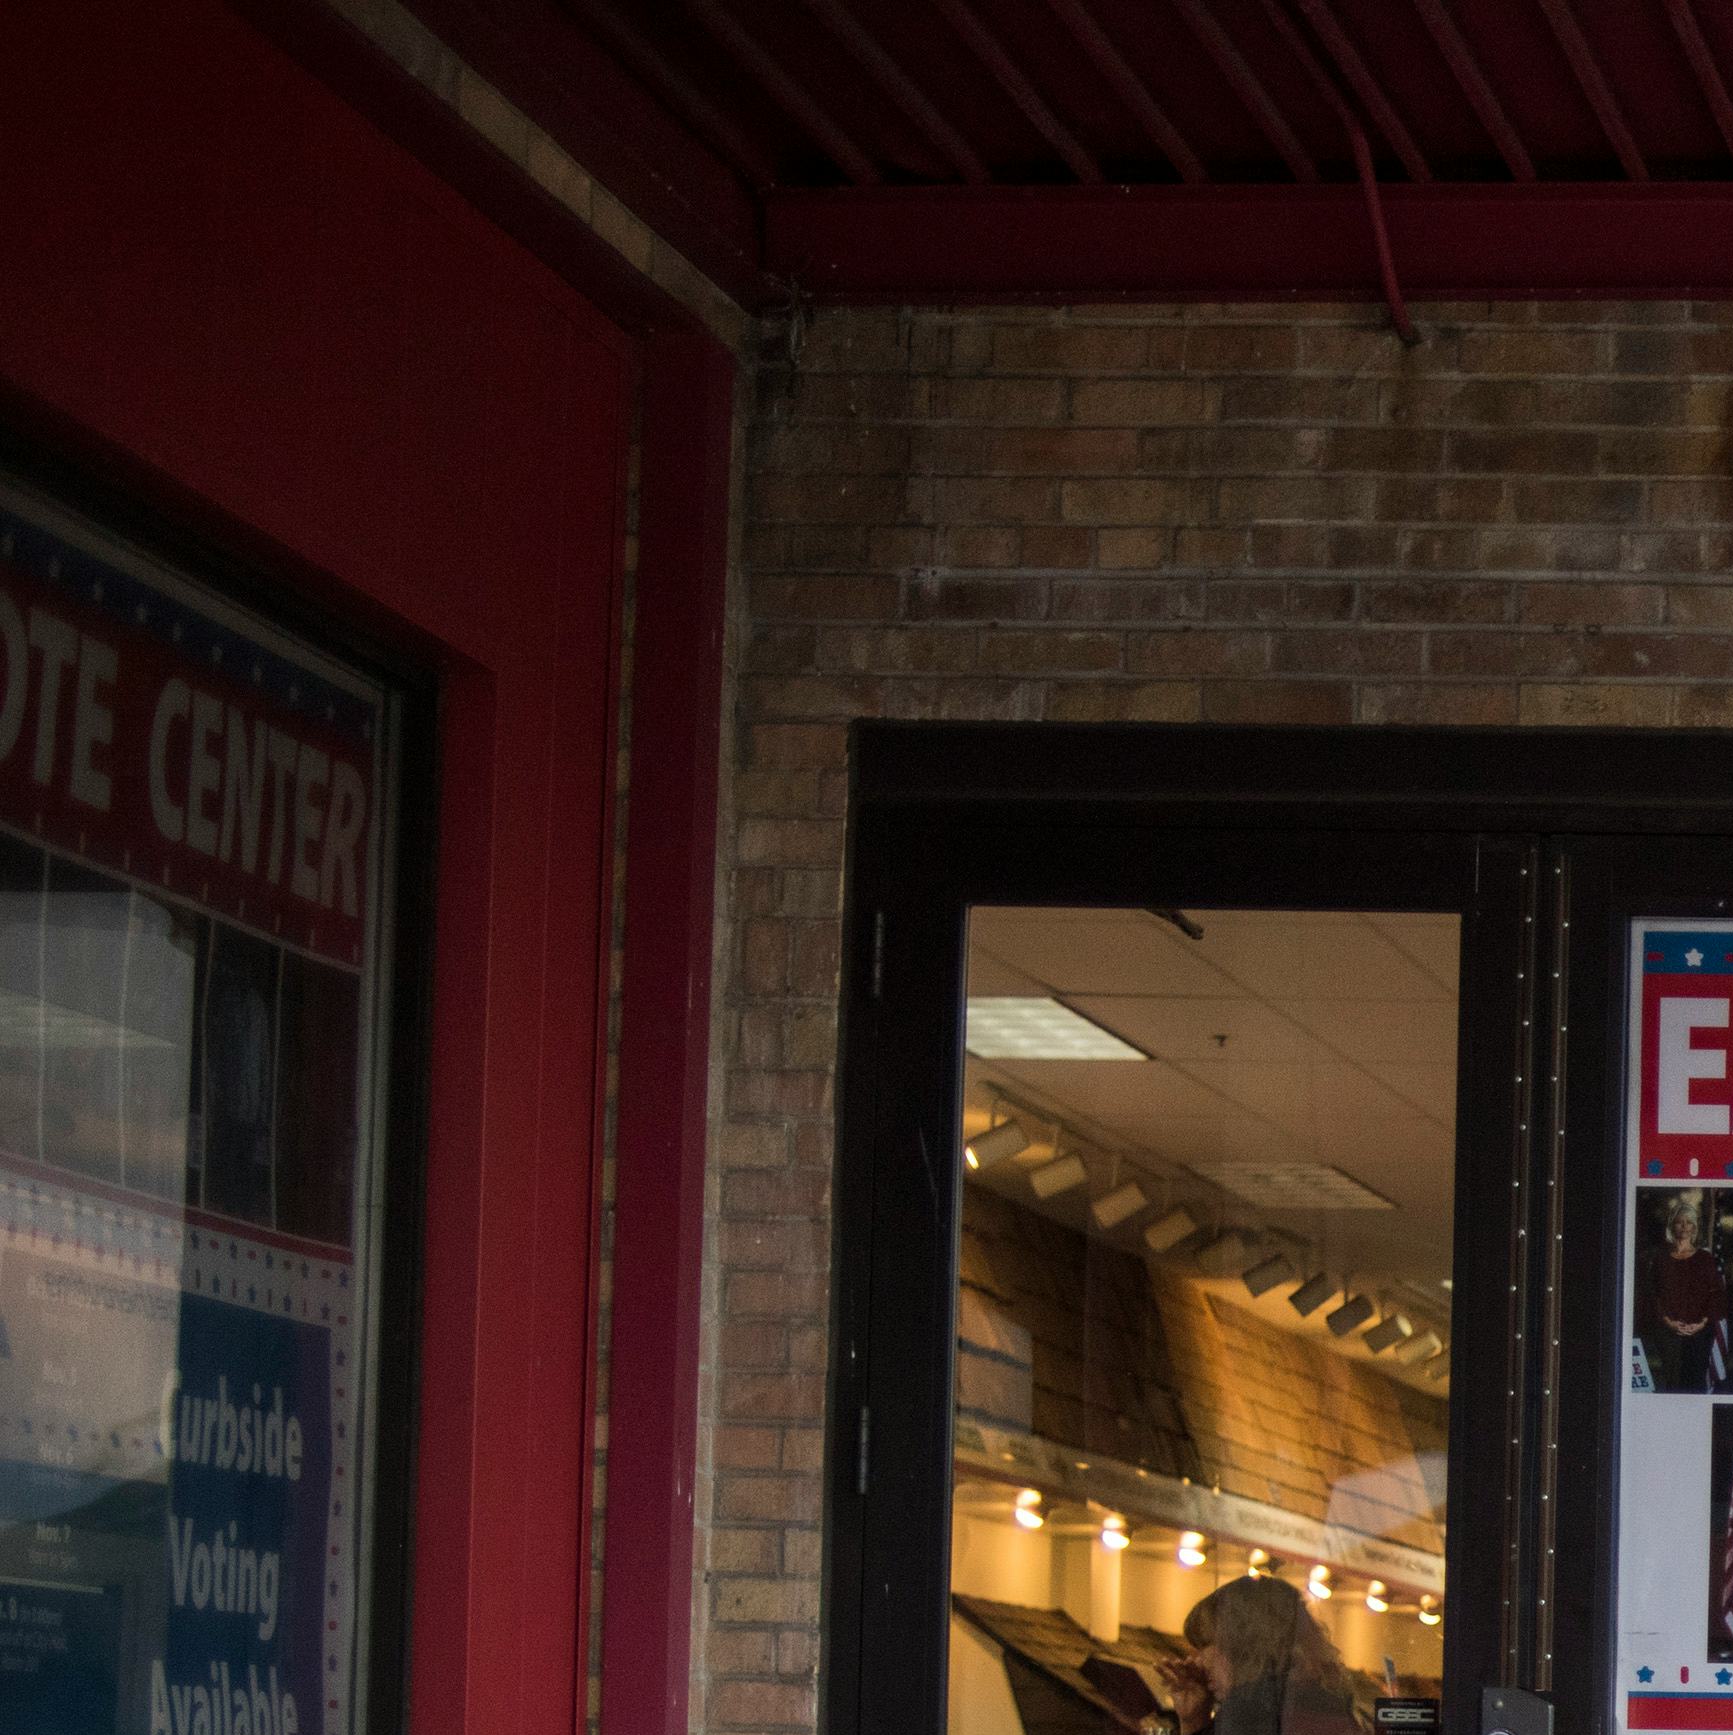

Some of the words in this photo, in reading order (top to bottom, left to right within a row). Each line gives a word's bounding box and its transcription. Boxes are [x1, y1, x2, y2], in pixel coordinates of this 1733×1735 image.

[150, 678, 367, 918] CENTER
[159, 1370, 301, 1480] Curbside
[168, 1514, 280, 1641] Voting
